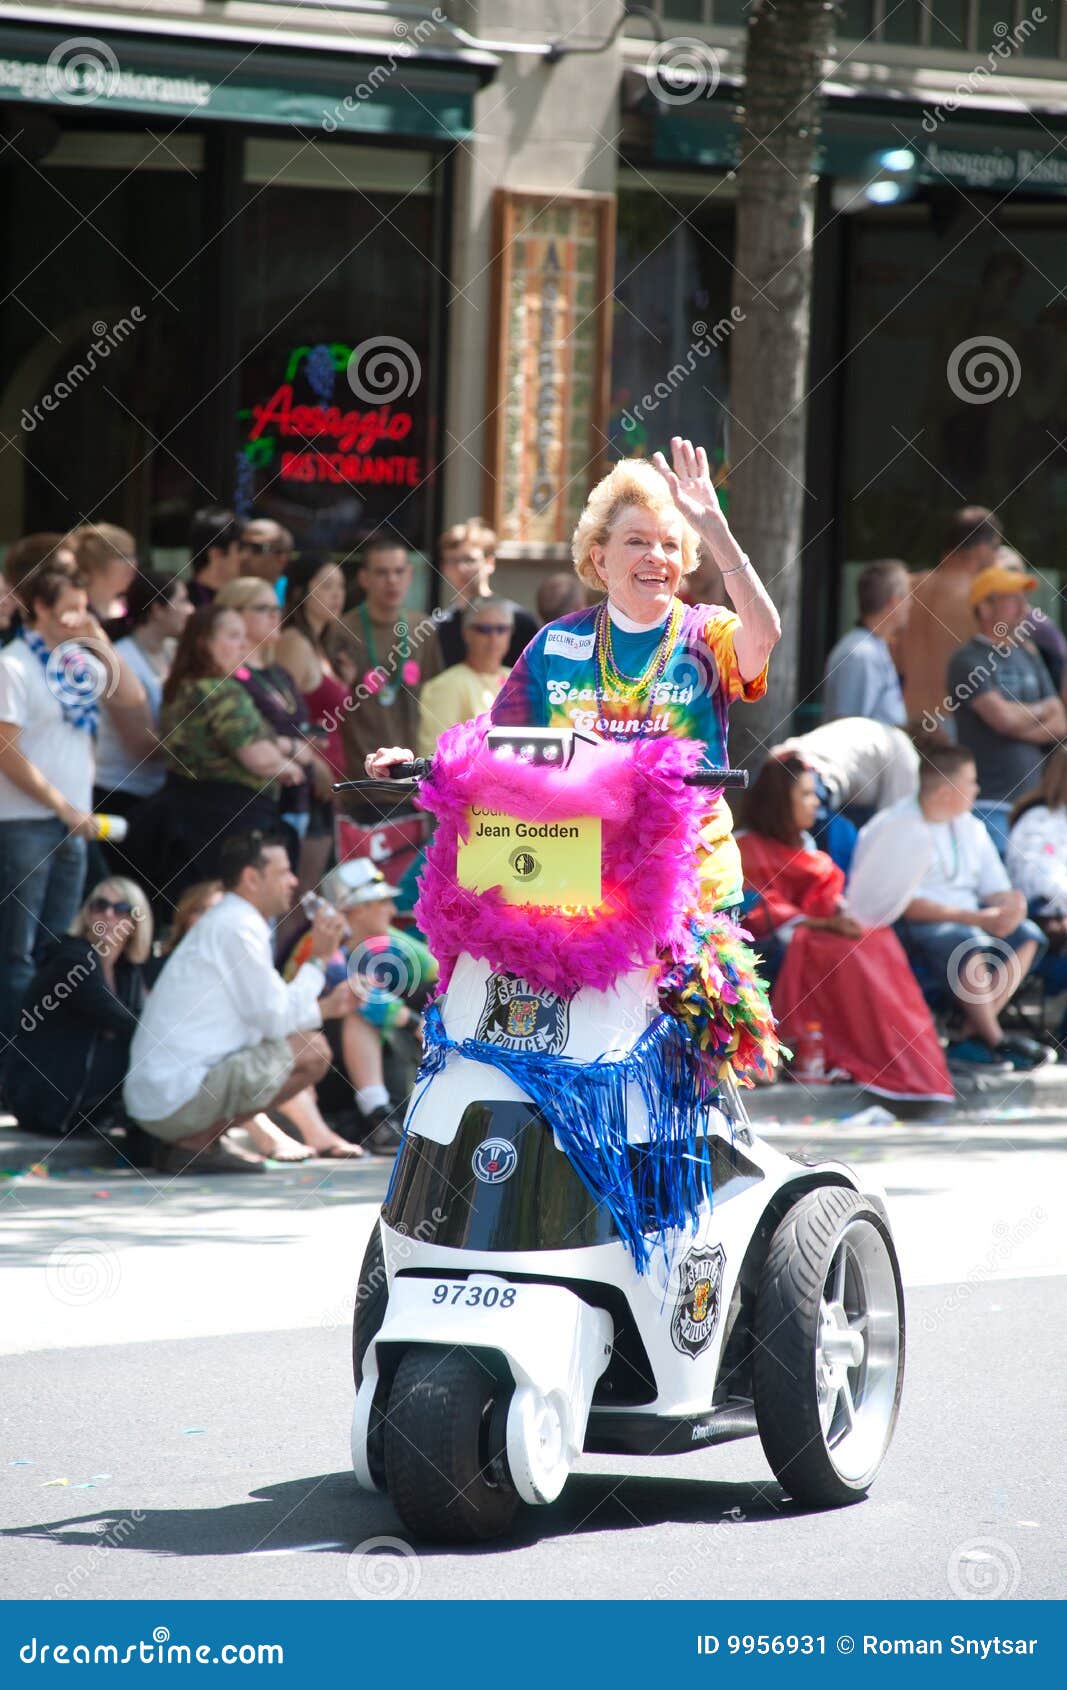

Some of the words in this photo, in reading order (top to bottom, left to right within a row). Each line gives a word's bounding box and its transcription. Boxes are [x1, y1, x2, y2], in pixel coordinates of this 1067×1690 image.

[281, 451, 423, 486] RISTORANTE
[569, 708, 671, 733] Council
[476, 822, 511, 837] Jean
[515, 823, 579, 838] Godden
[499, 979, 555, 1004] SEATLE
[493, 1033, 544, 1053] POLICE
[432, 1284, 517, 1308] 97308
[683, 1320, 711, 1340] POLICE
